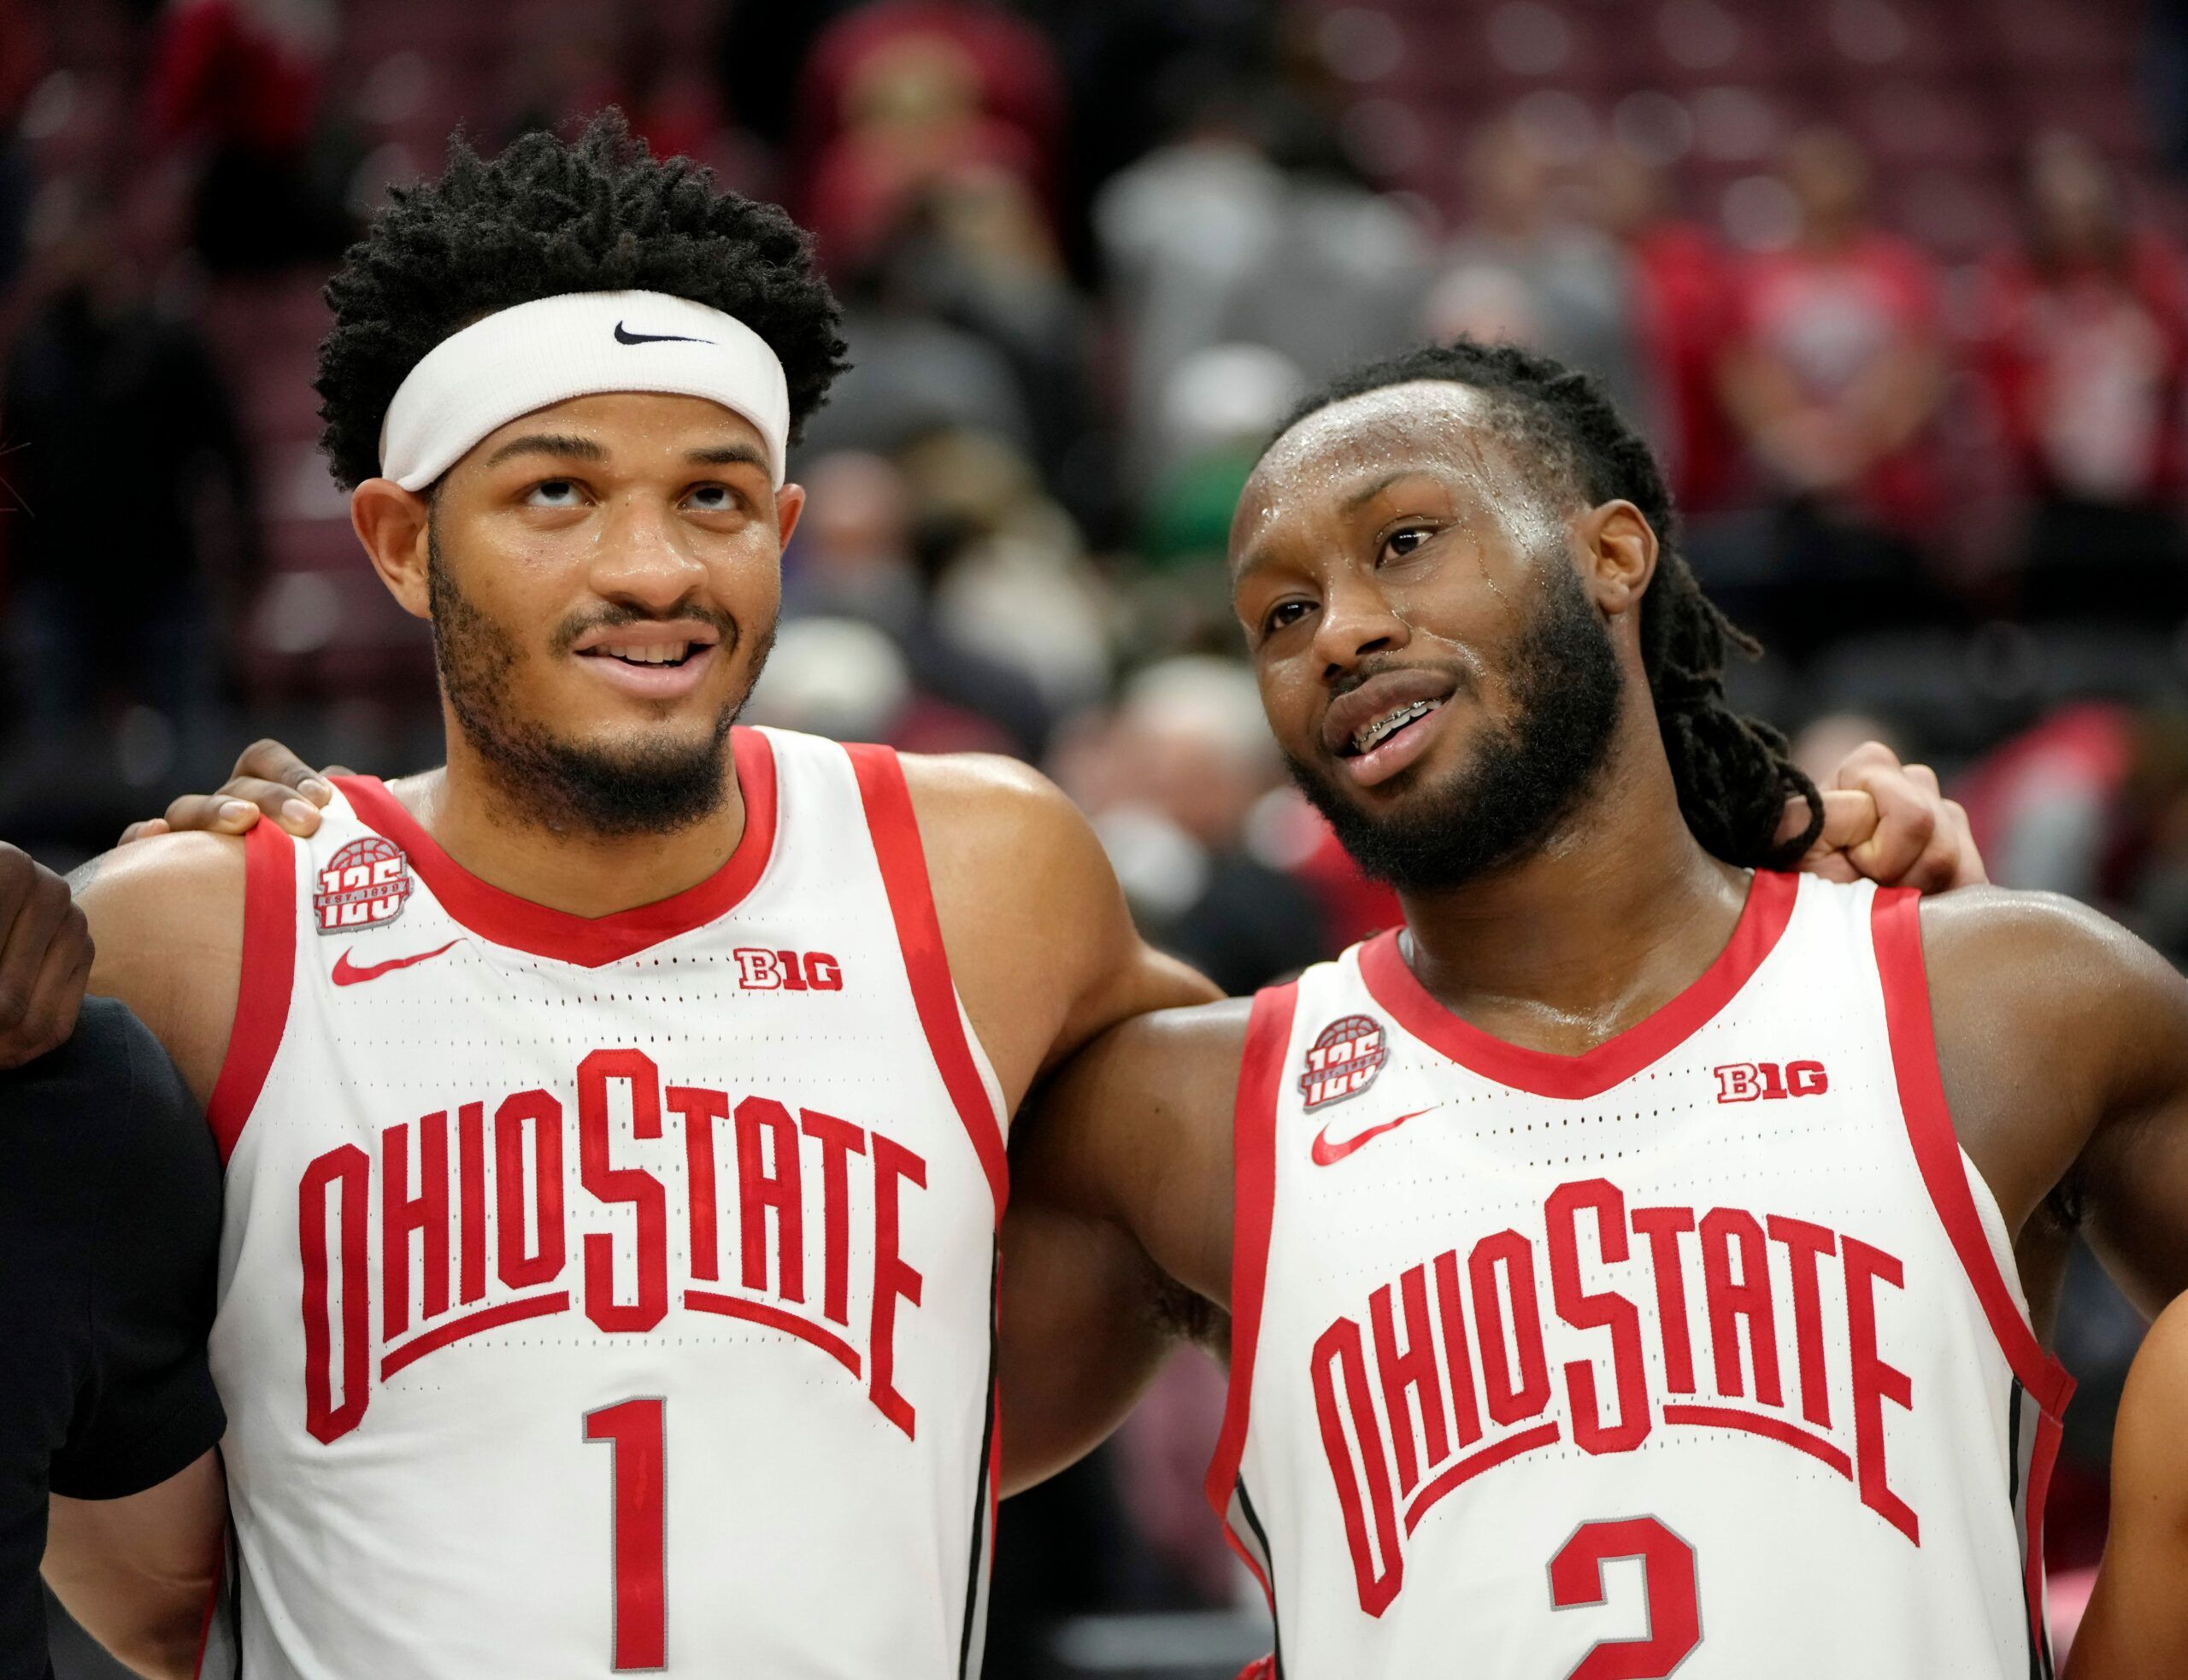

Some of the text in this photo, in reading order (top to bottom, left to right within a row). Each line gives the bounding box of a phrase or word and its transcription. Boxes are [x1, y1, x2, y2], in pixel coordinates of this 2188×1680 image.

[298, 1048, 927, 1445] OHIO STATE
[1310, 1178, 1920, 1618] OHIO STATE
[581, 1395, 669, 1673] 1
[1546, 1513, 1703, 1680] 2
